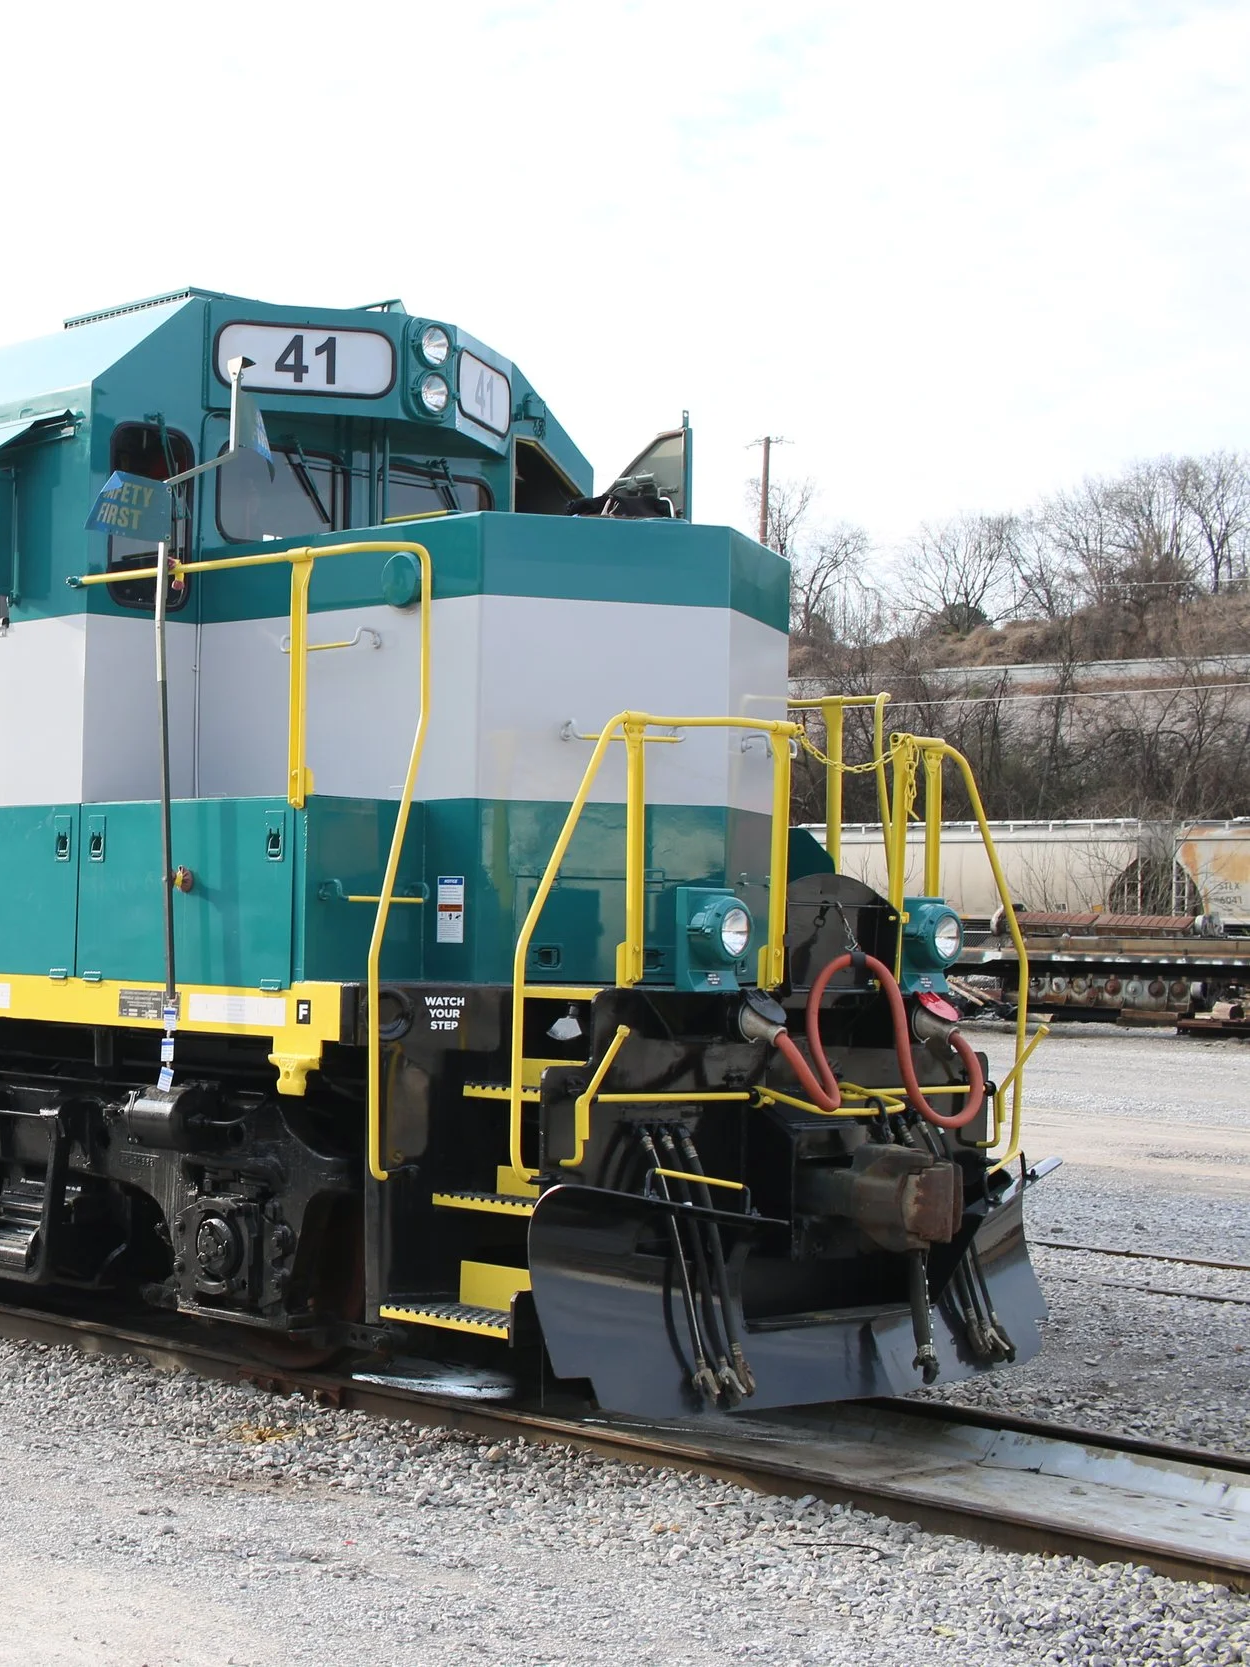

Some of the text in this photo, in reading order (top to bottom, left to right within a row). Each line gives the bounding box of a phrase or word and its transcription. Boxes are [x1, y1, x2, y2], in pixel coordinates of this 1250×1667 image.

[275, 334, 336, 385] 41
[475, 369, 494, 421] 41
[96, 502, 142, 529] FIRST
[424, 996, 465, 1006] WATCH
[299, 1004, 308, 1020] F
[429, 1008, 461, 1018] YOUR
[430, 1020, 459, 1030] STEP
